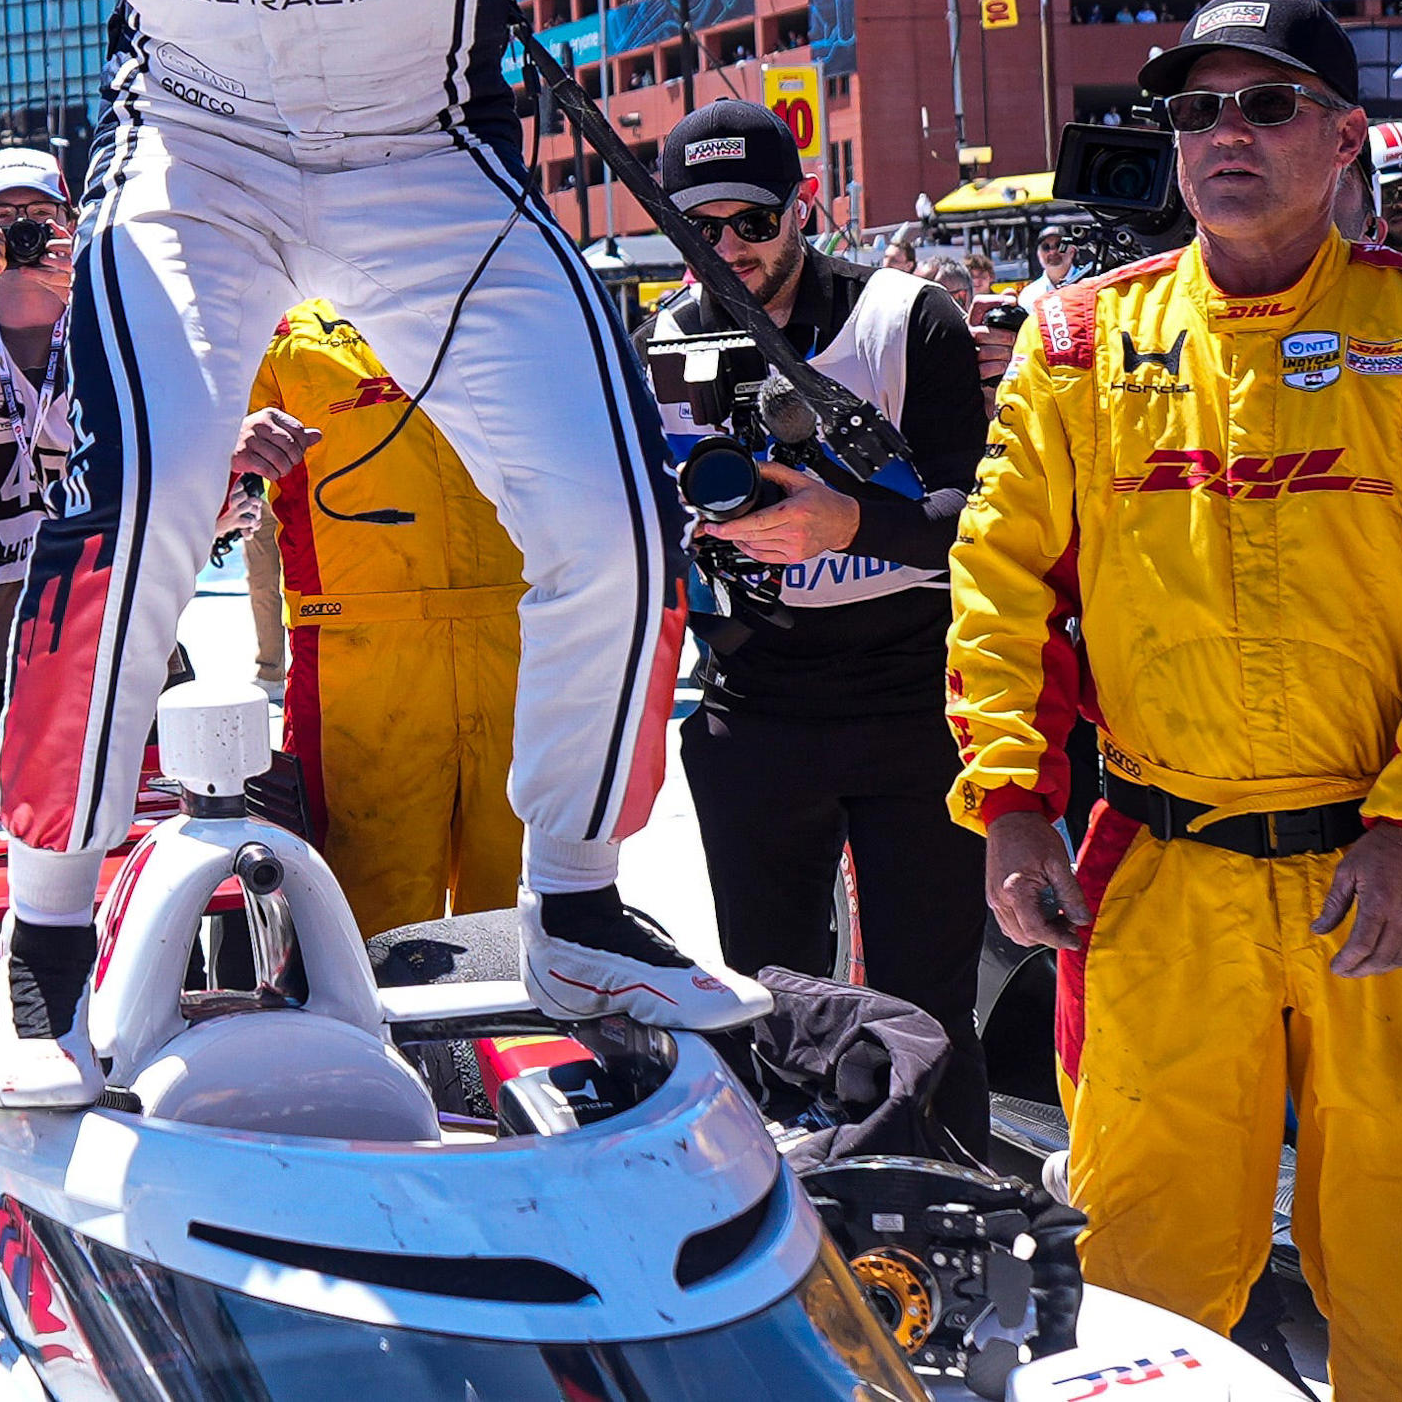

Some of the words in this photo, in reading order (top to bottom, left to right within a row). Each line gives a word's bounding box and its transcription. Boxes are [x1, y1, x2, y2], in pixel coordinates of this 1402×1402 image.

[162, 77, 235, 115] sparco
[1218, 303, 1292, 319] DHL
[1305, 339, 1335, 352] NTT
[1283, 352, 1340, 368] INDYCAR
[1111, 380, 1191, 395] Honda
[1139, 447, 1356, 500] DHL
[299, 601, 343, 617] sparco
[1104, 740, 1143, 781] sparco
